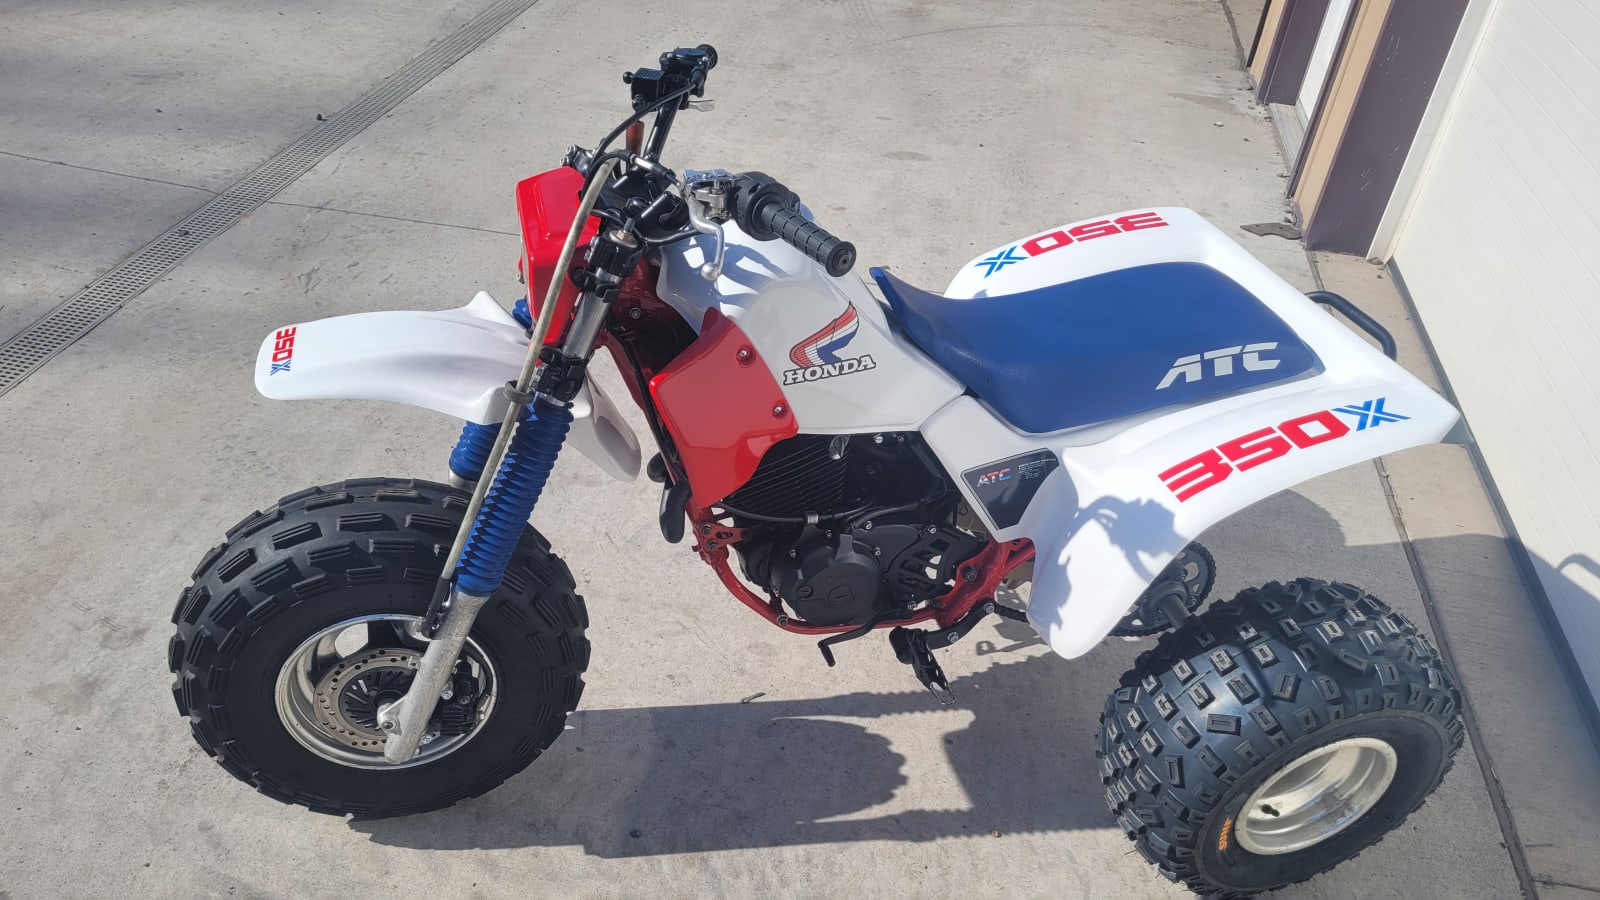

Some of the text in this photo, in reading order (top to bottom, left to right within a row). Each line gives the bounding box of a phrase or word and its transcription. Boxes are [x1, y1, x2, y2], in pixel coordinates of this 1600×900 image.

[974, 212, 1169, 279] 350X
[269, 326, 297, 376] 350X
[783, 354, 876, 386] HONDA
[1155, 341, 1281, 390] ATC
[1157, 397, 1411, 503] 350X
[977, 467, 1012, 488] ATC
